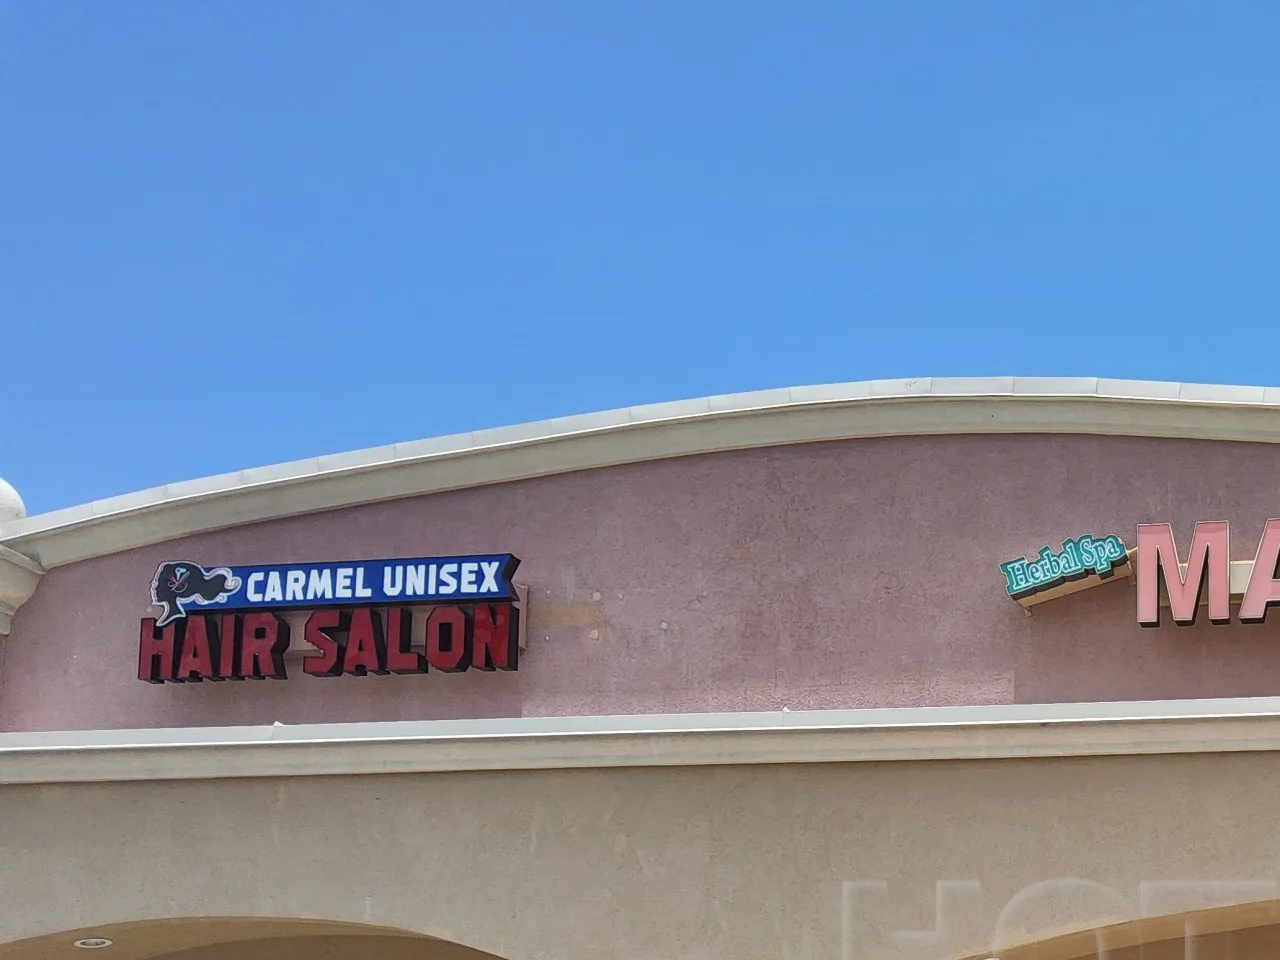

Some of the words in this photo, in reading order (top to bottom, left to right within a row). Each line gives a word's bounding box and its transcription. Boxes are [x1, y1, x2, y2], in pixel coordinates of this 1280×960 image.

[246, 567, 372, 602] CARMEL
[382, 560, 500, 597] UNISEX
[1007, 541, 1082, 590] Herbal
[1079, 536, 1120, 571] Spa
[137, 611, 289, 683] HAIR
[302, 603, 518, 676] SALON
